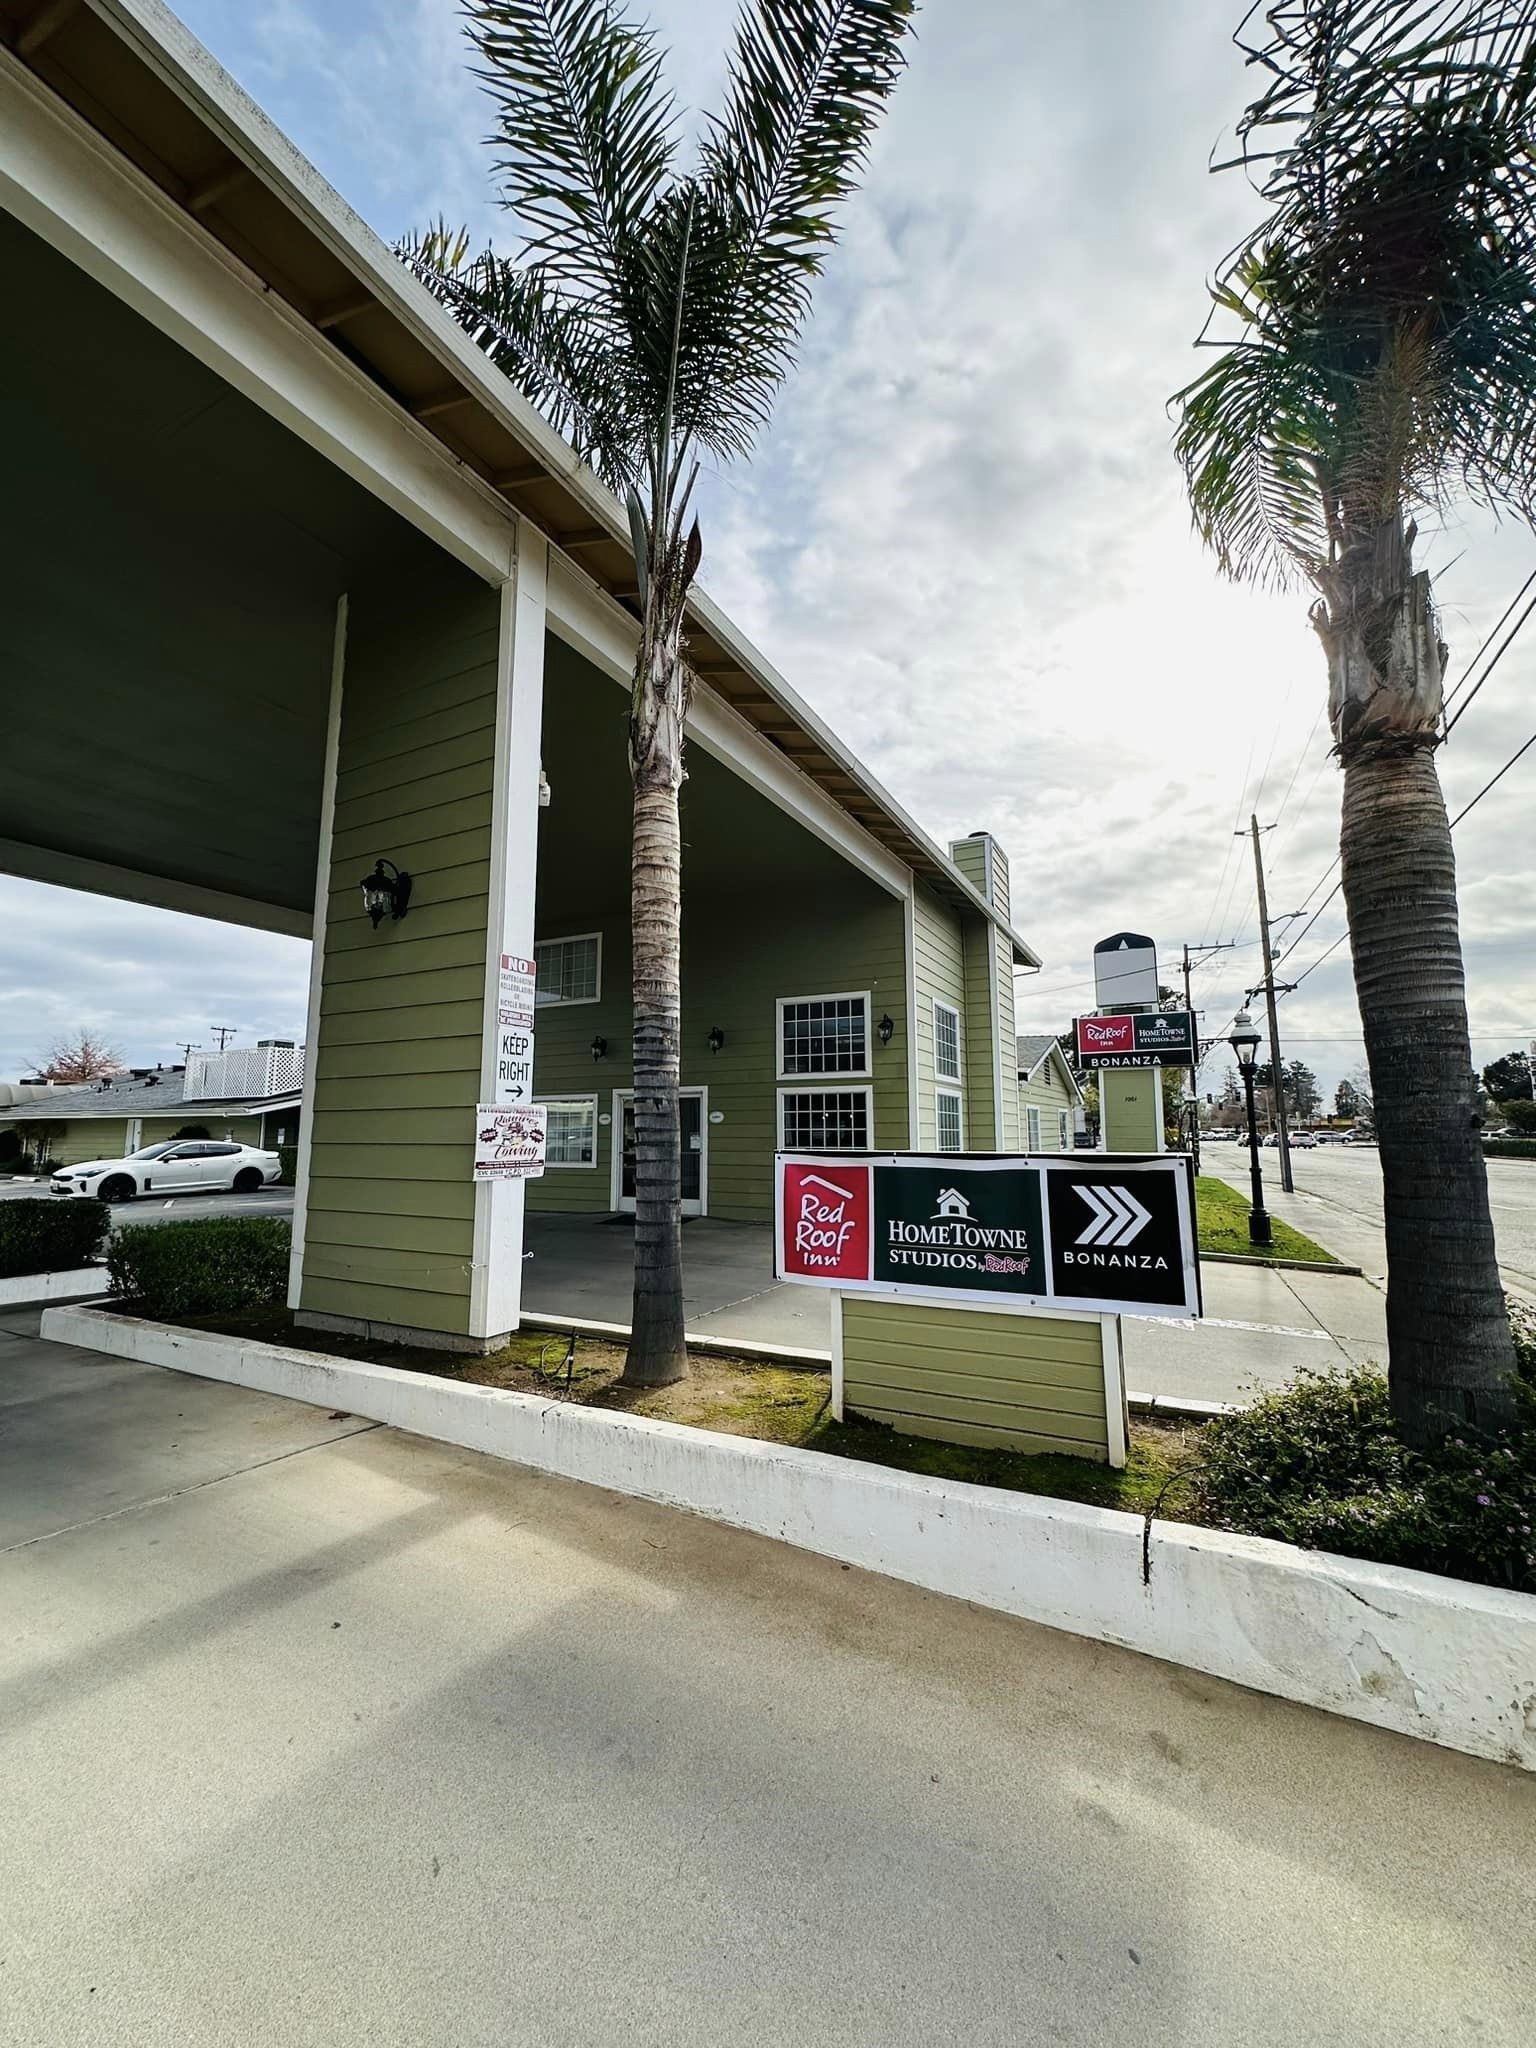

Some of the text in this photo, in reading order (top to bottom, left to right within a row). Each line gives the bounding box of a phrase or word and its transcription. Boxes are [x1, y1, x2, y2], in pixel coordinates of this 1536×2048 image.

[508, 957, 529, 973] NO
[503, 1035, 529, 1056] KEEP
[500, 1060, 530, 1081] RIGHT
[1091, 1055, 1162, 1067] BONANZA
[801, 1194, 845, 1223] Red
[796, 1221, 856, 1255] Roof
[888, 1220, 1028, 1250] HOMETOWNE
[803, 1252, 838, 1266] Inn
[889, 1249, 978, 1269] STUDIOS
[978, 1261, 986, 1272] by
[1064, 1251, 1168, 1270] BONANZA
